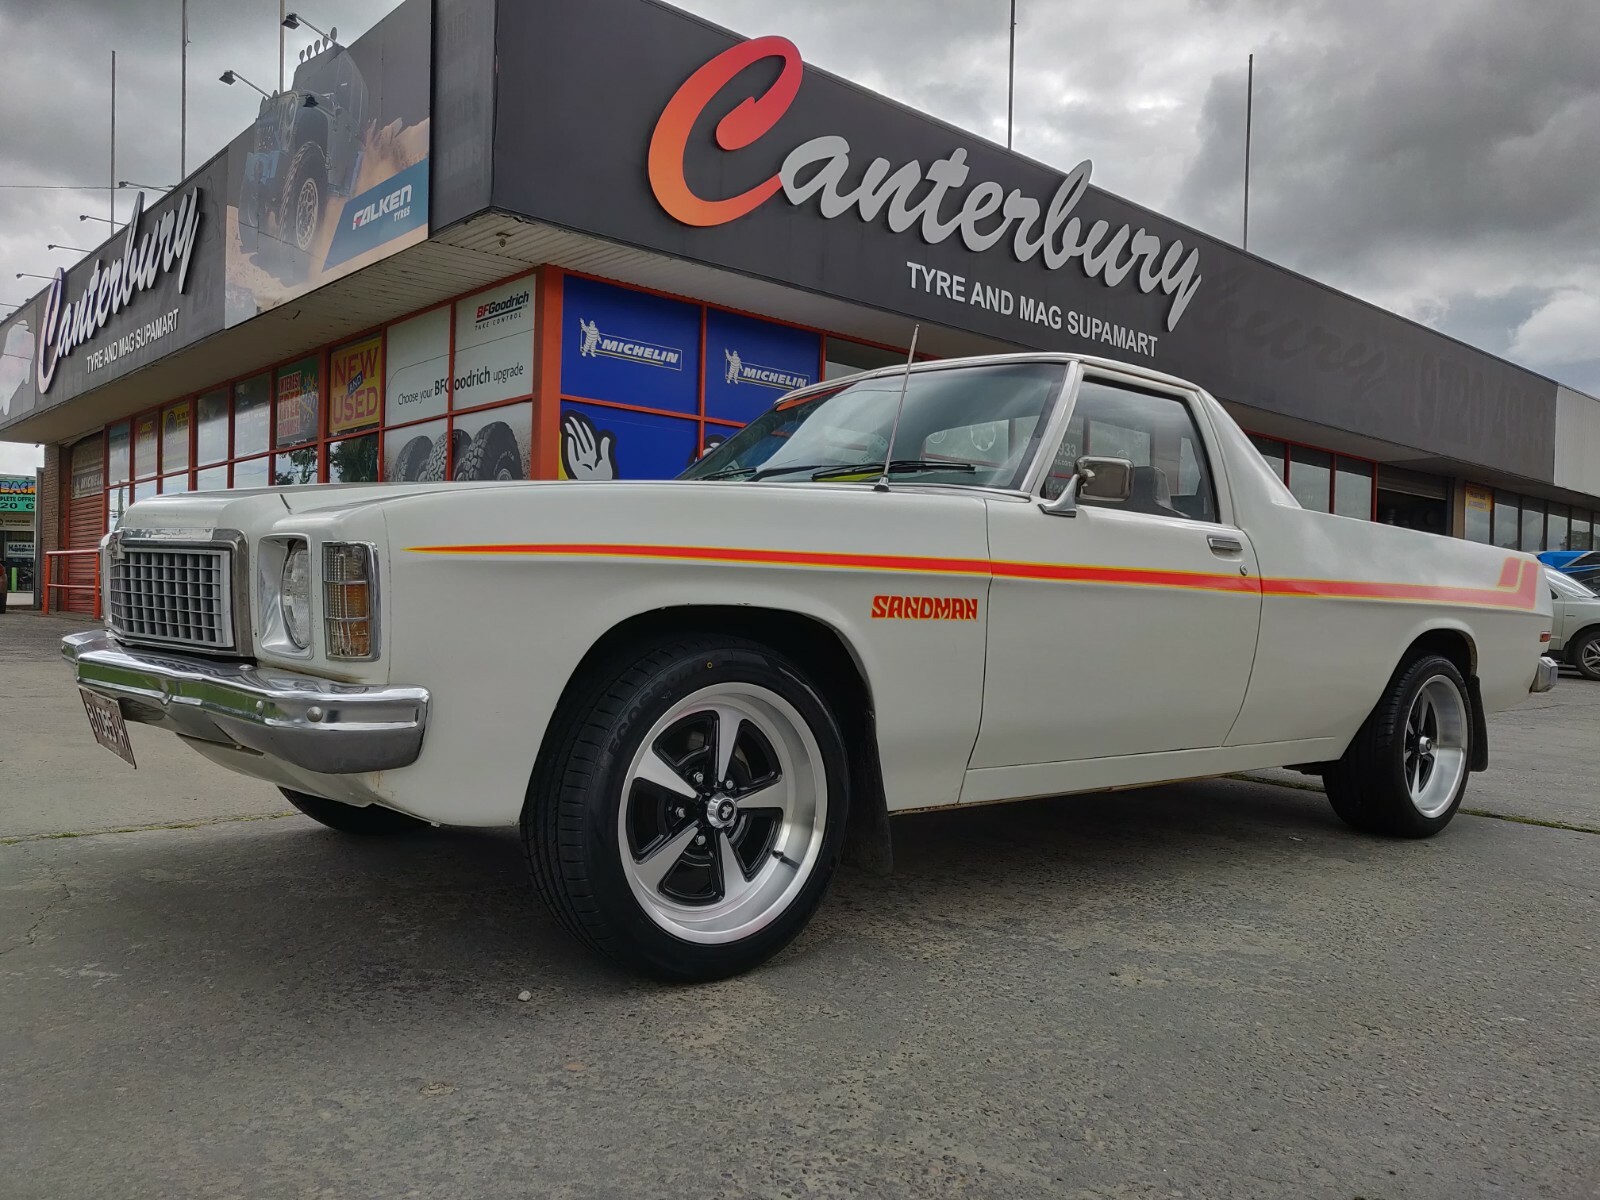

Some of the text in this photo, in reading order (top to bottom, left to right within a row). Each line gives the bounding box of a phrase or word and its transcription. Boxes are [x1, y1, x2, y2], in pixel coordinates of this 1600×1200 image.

[648, 35, 1200, 332] Canterbury
[352, 184, 412, 230] FALKEN
[393, 207, 411, 222] TYRES
[38, 186, 200, 393] Canterbury
[476, 290, 529, 319] BFGoodrich
[906, 261, 1158, 358] TYRE AND MAG SUPAMART
[86, 308, 179, 374] TYRE AND MAG SUPAMART
[474, 312, 521, 331] TAKE CONTROL
[333, 346, 380, 386] NEW
[601, 339, 679, 364] MICHELIN
[347, 372, 363, 395] AND
[397, 391, 419, 405] Choose
[419, 387, 434, 404] your
[493, 362, 524, 384] upgrade
[743, 367, 807, 388] MICHELIN
[332, 385, 379, 425] USED
[871, 595, 978, 620] SANDMAN
